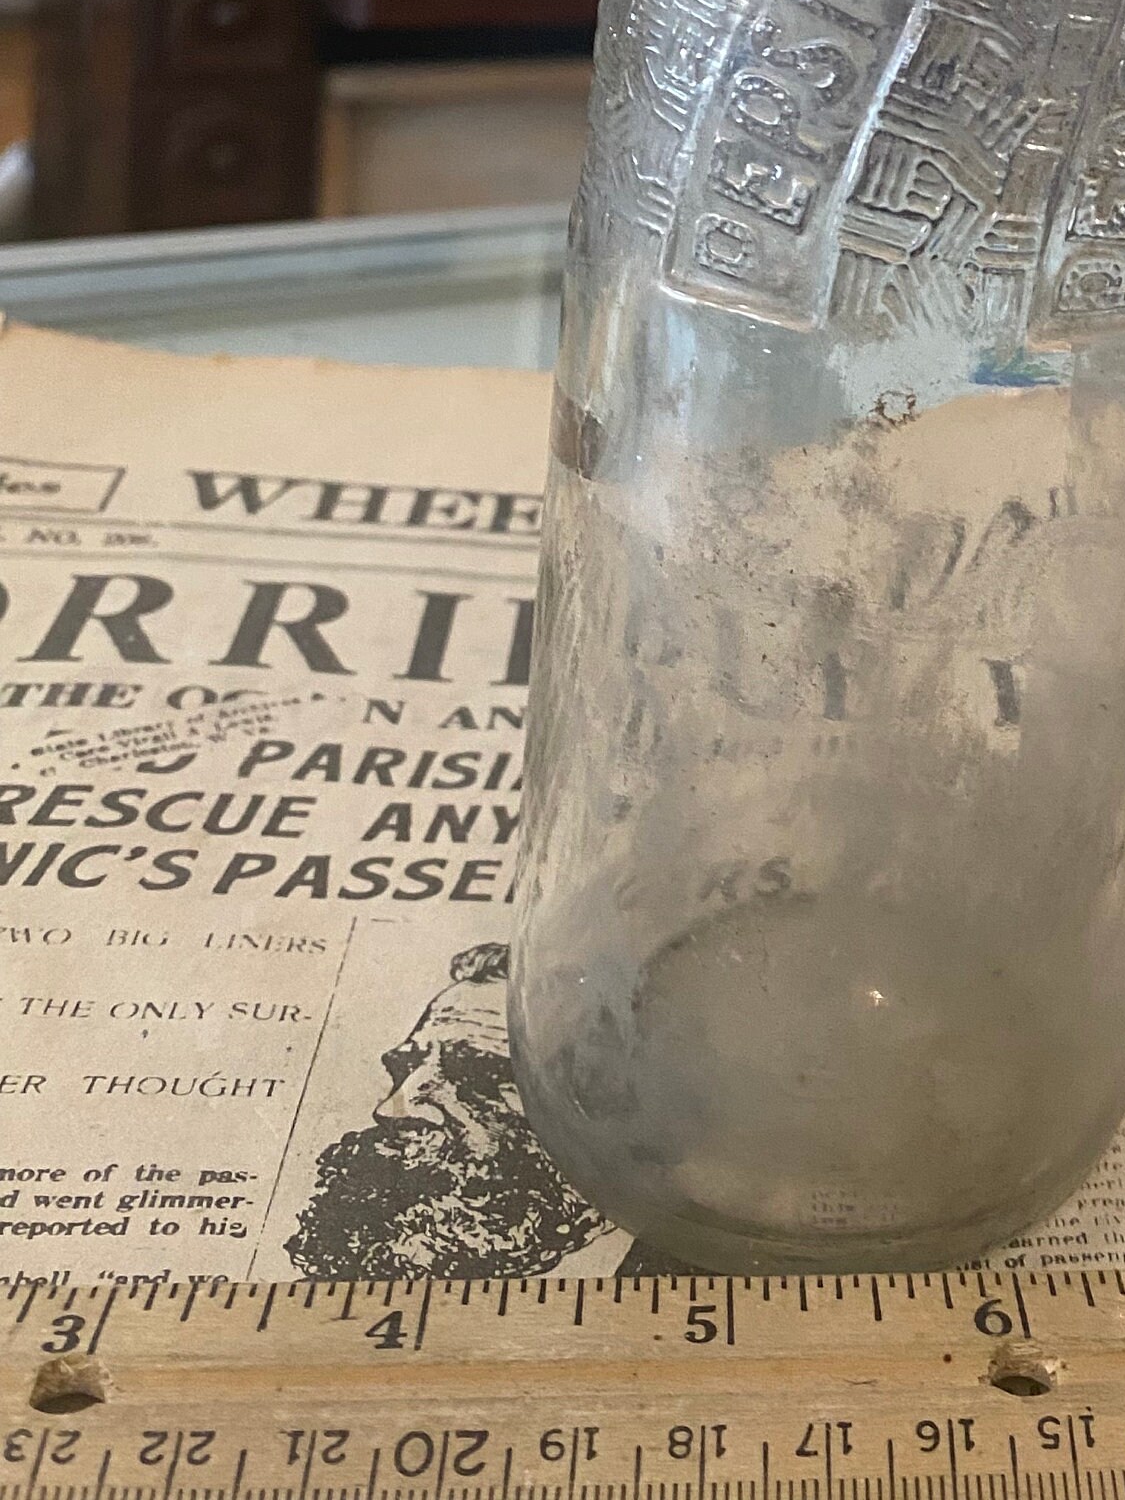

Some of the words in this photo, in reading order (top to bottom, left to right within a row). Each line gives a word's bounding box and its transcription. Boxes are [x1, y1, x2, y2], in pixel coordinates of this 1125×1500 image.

[0, 682, 143, 707] THE
[237, 739, 523, 790] PARISI
[212, 853, 515, 904] PASSE
[0, 927, 72, 945] WO
[105, 929, 168, 946] BIG
[203, 931, 327, 955] LINERS
[19, 997, 95, 1018] THE
[109, 1001, 215, 1021] ONLY
[229, 1002, 313, 1022] SUR-
[82, 1075, 286, 1098] THOUGHT
[83, 1164, 118, 1182] of
[135, 1164, 181, 1182] the
[198, 1168, 257, 1186] pas-
[34, 1191, 104, 1209] went
[116, 1190, 254, 1212] glimmer-
[149, 1217, 180, 1236] to
[1004, 1253, 1026, 1269] of
[41, 1313, 87, 1355] 3
[365, 1310, 408, 1350] 4
[684, 1304, 719, 1345] 5
[973, 1299, 1013, 1337] 6
[2, 1429, 81, 1465] 23
[139, 1429, 217, 1466] 22
[285, 1429, 350, 1465] 21
[394, 1429, 490, 1478] 20
[539, 1426, 601, 1462] 19
[668, 1423, 728, 1459] 18
[795, 1420, 853, 1457] 17
[916, 1417, 976, 1453] 16
[1037, 1413, 1096, 1450] 15
